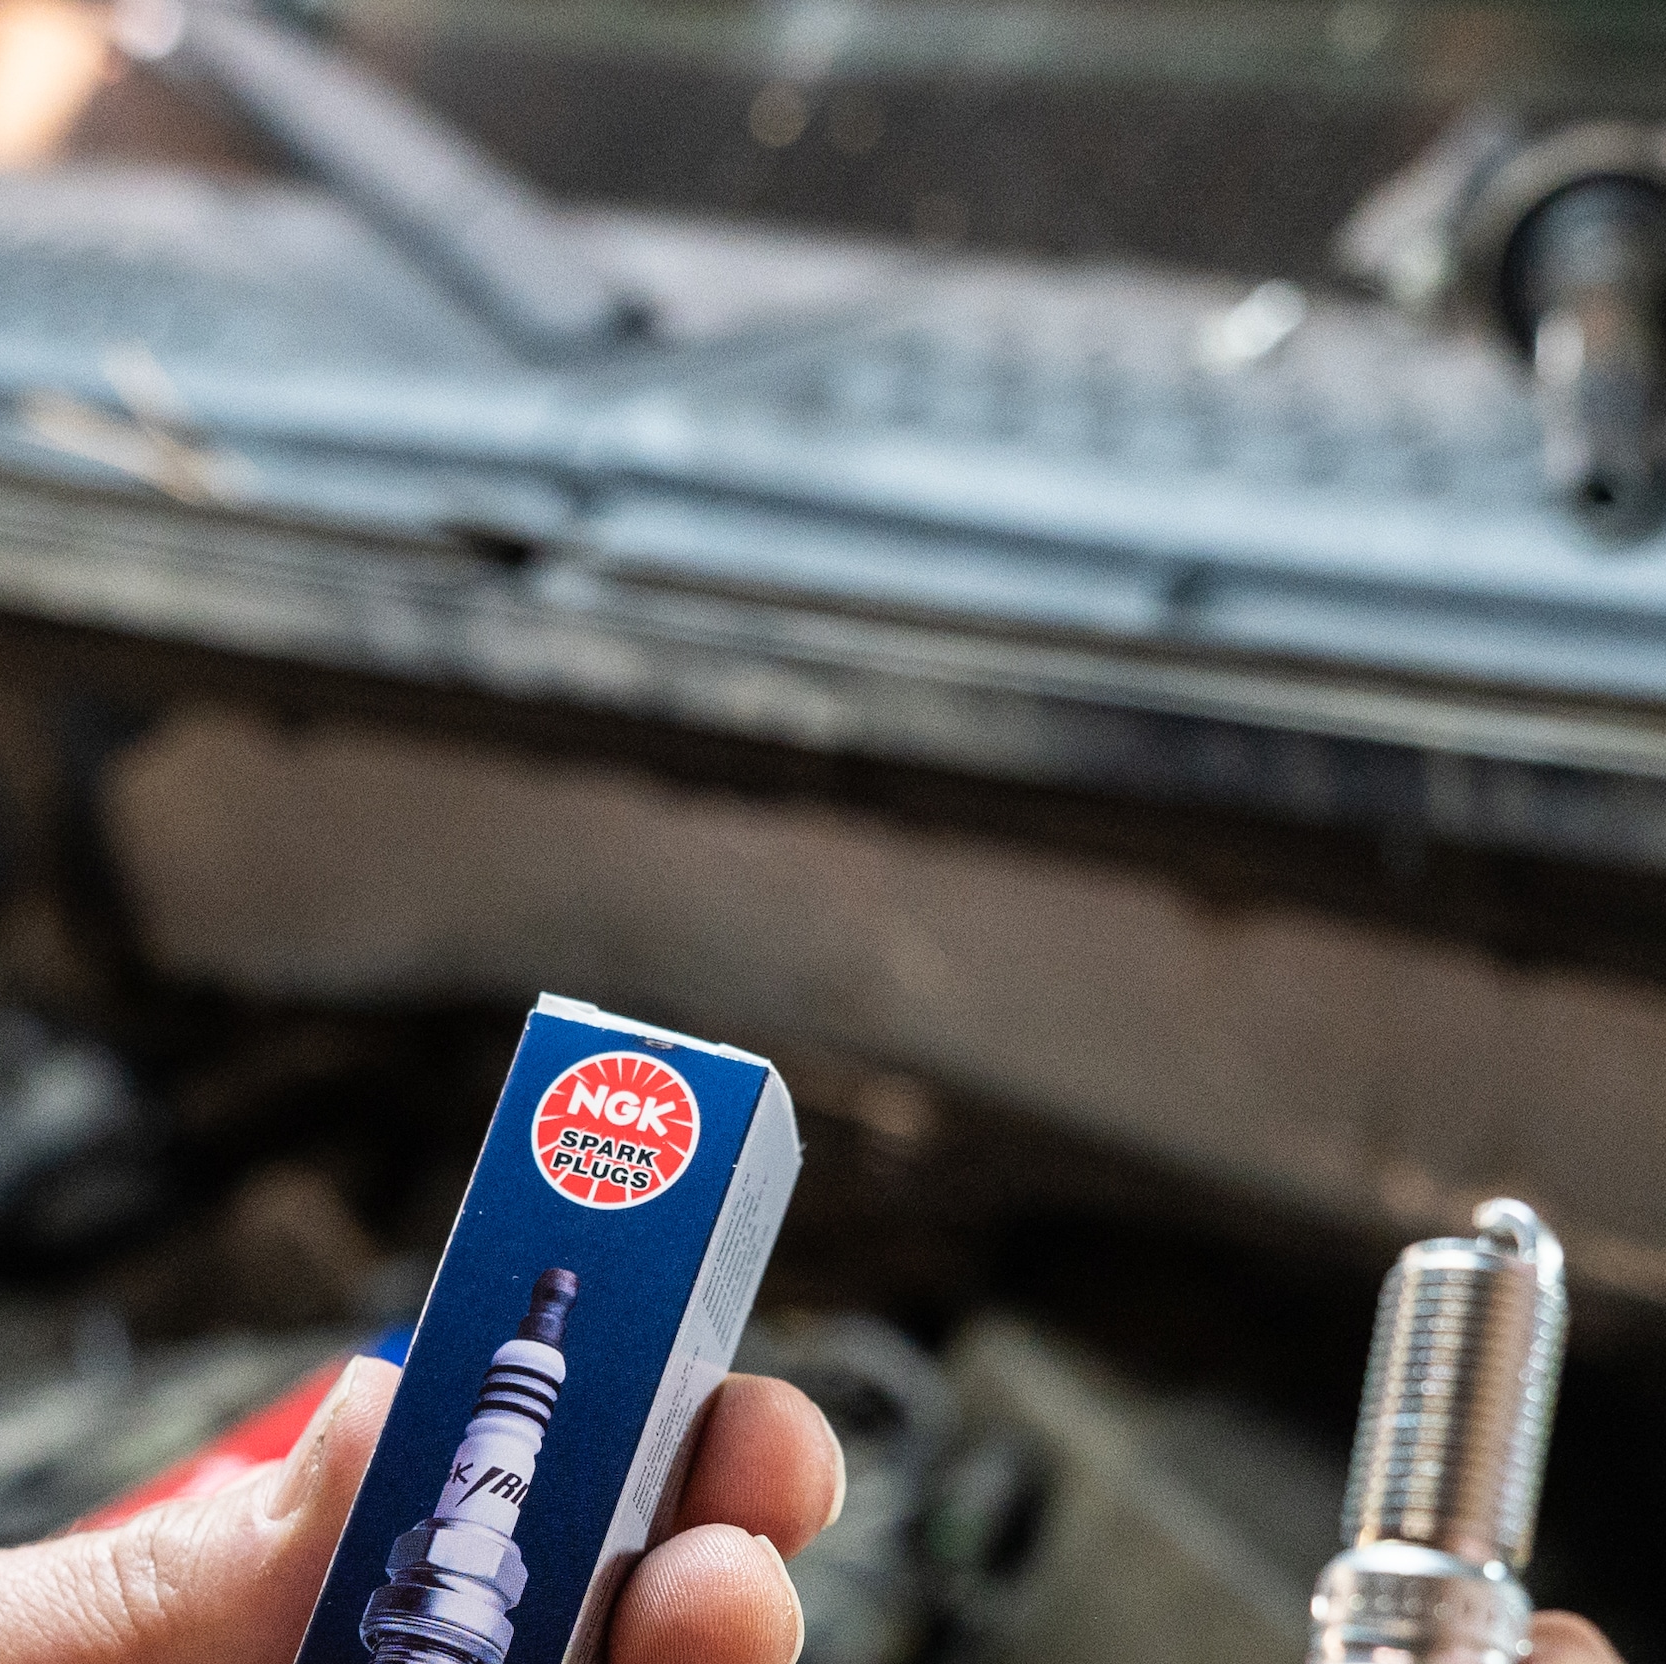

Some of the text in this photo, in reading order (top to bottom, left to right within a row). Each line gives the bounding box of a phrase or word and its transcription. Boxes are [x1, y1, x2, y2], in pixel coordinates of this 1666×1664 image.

[567, 1080, 676, 1137] NGK
[560, 1130, 656, 1168] SPARK
[552, 1152, 649, 1189] PLUGS
[455, 1466, 531, 1509] IRI
